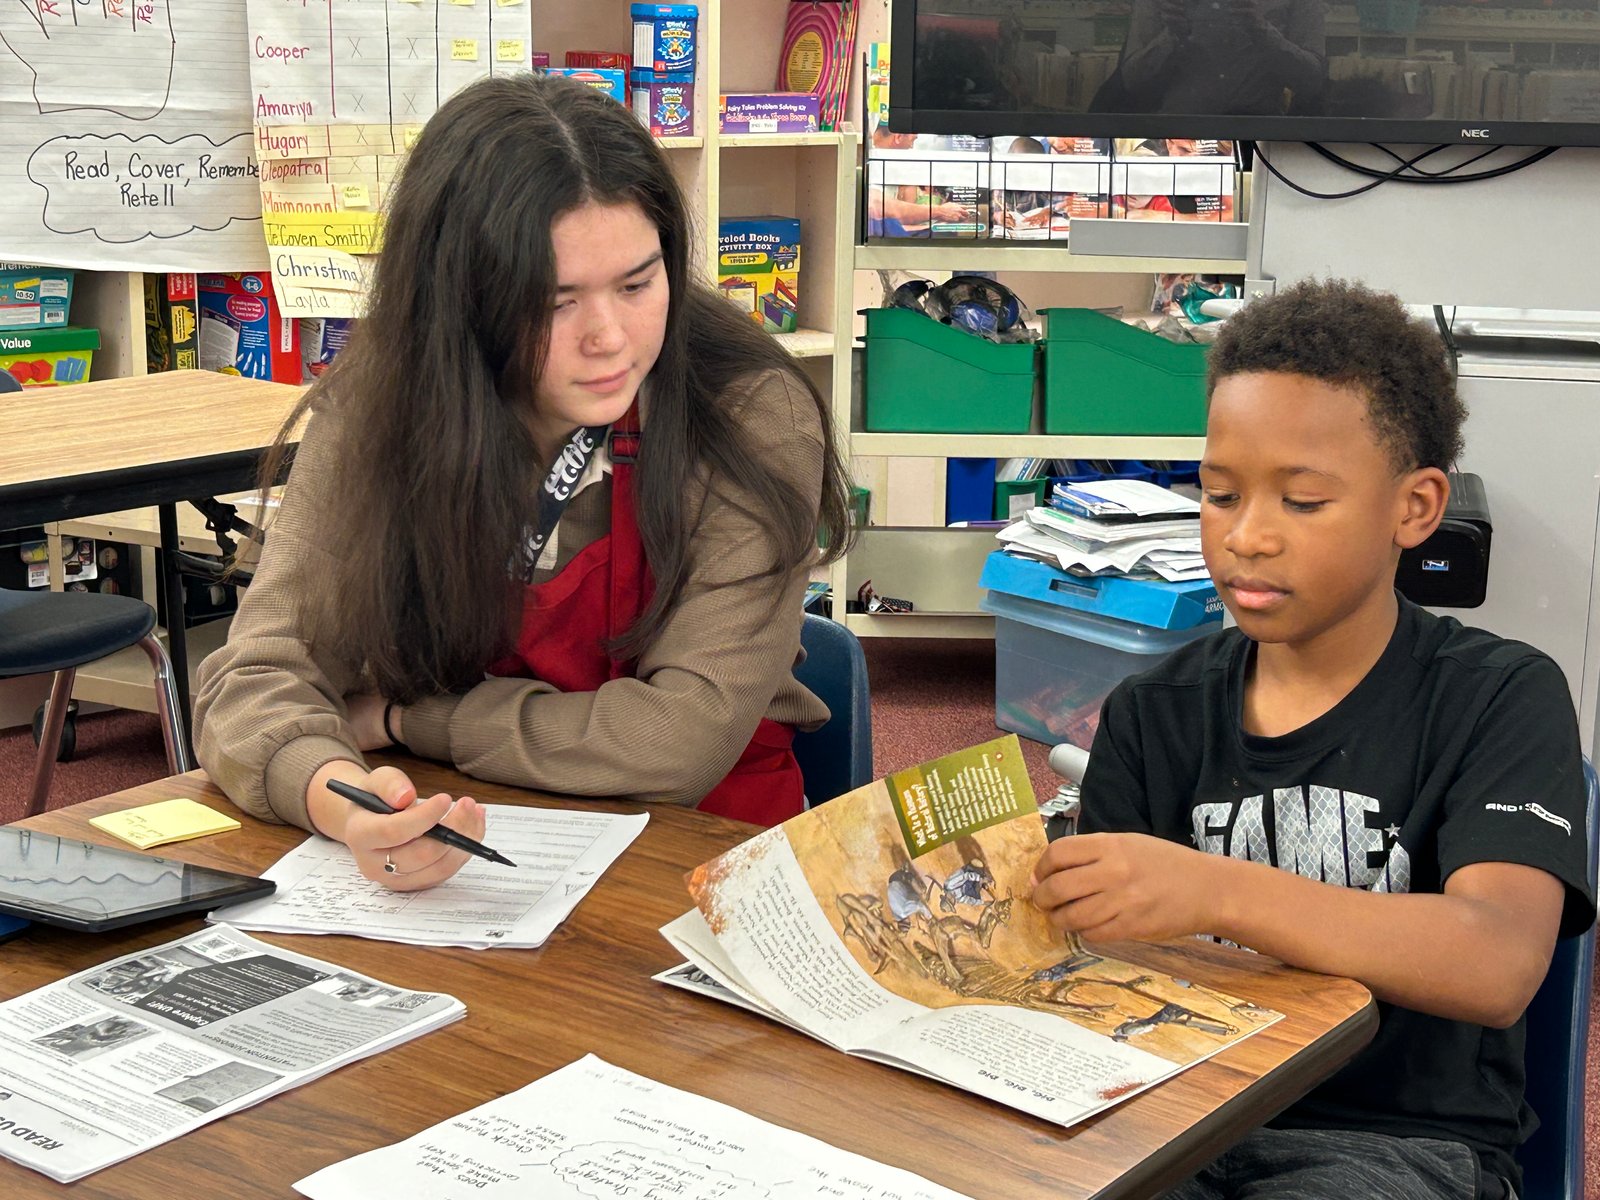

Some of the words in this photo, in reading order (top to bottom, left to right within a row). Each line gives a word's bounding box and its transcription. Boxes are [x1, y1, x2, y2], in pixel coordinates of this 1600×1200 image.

[255, 36, 310, 65] Cooper
[779, 103, 797, 111] Solving
[1461, 129, 1490, 138] NEC
[260, 157, 322, 183] Cleopatra
[120, 182, 174, 207] Retell
[324, 224, 367, 247] Smith
[749, 233, 780, 243] Books
[276, 254, 359, 283] Christina
[284, 287, 331, 312] Layla
[1, 337, 32, 350] Value
[976, 1068, 999, 1081] DIG
[11, 1126, 63, 1151] READ
[491, 1134, 534, 1155] Check
